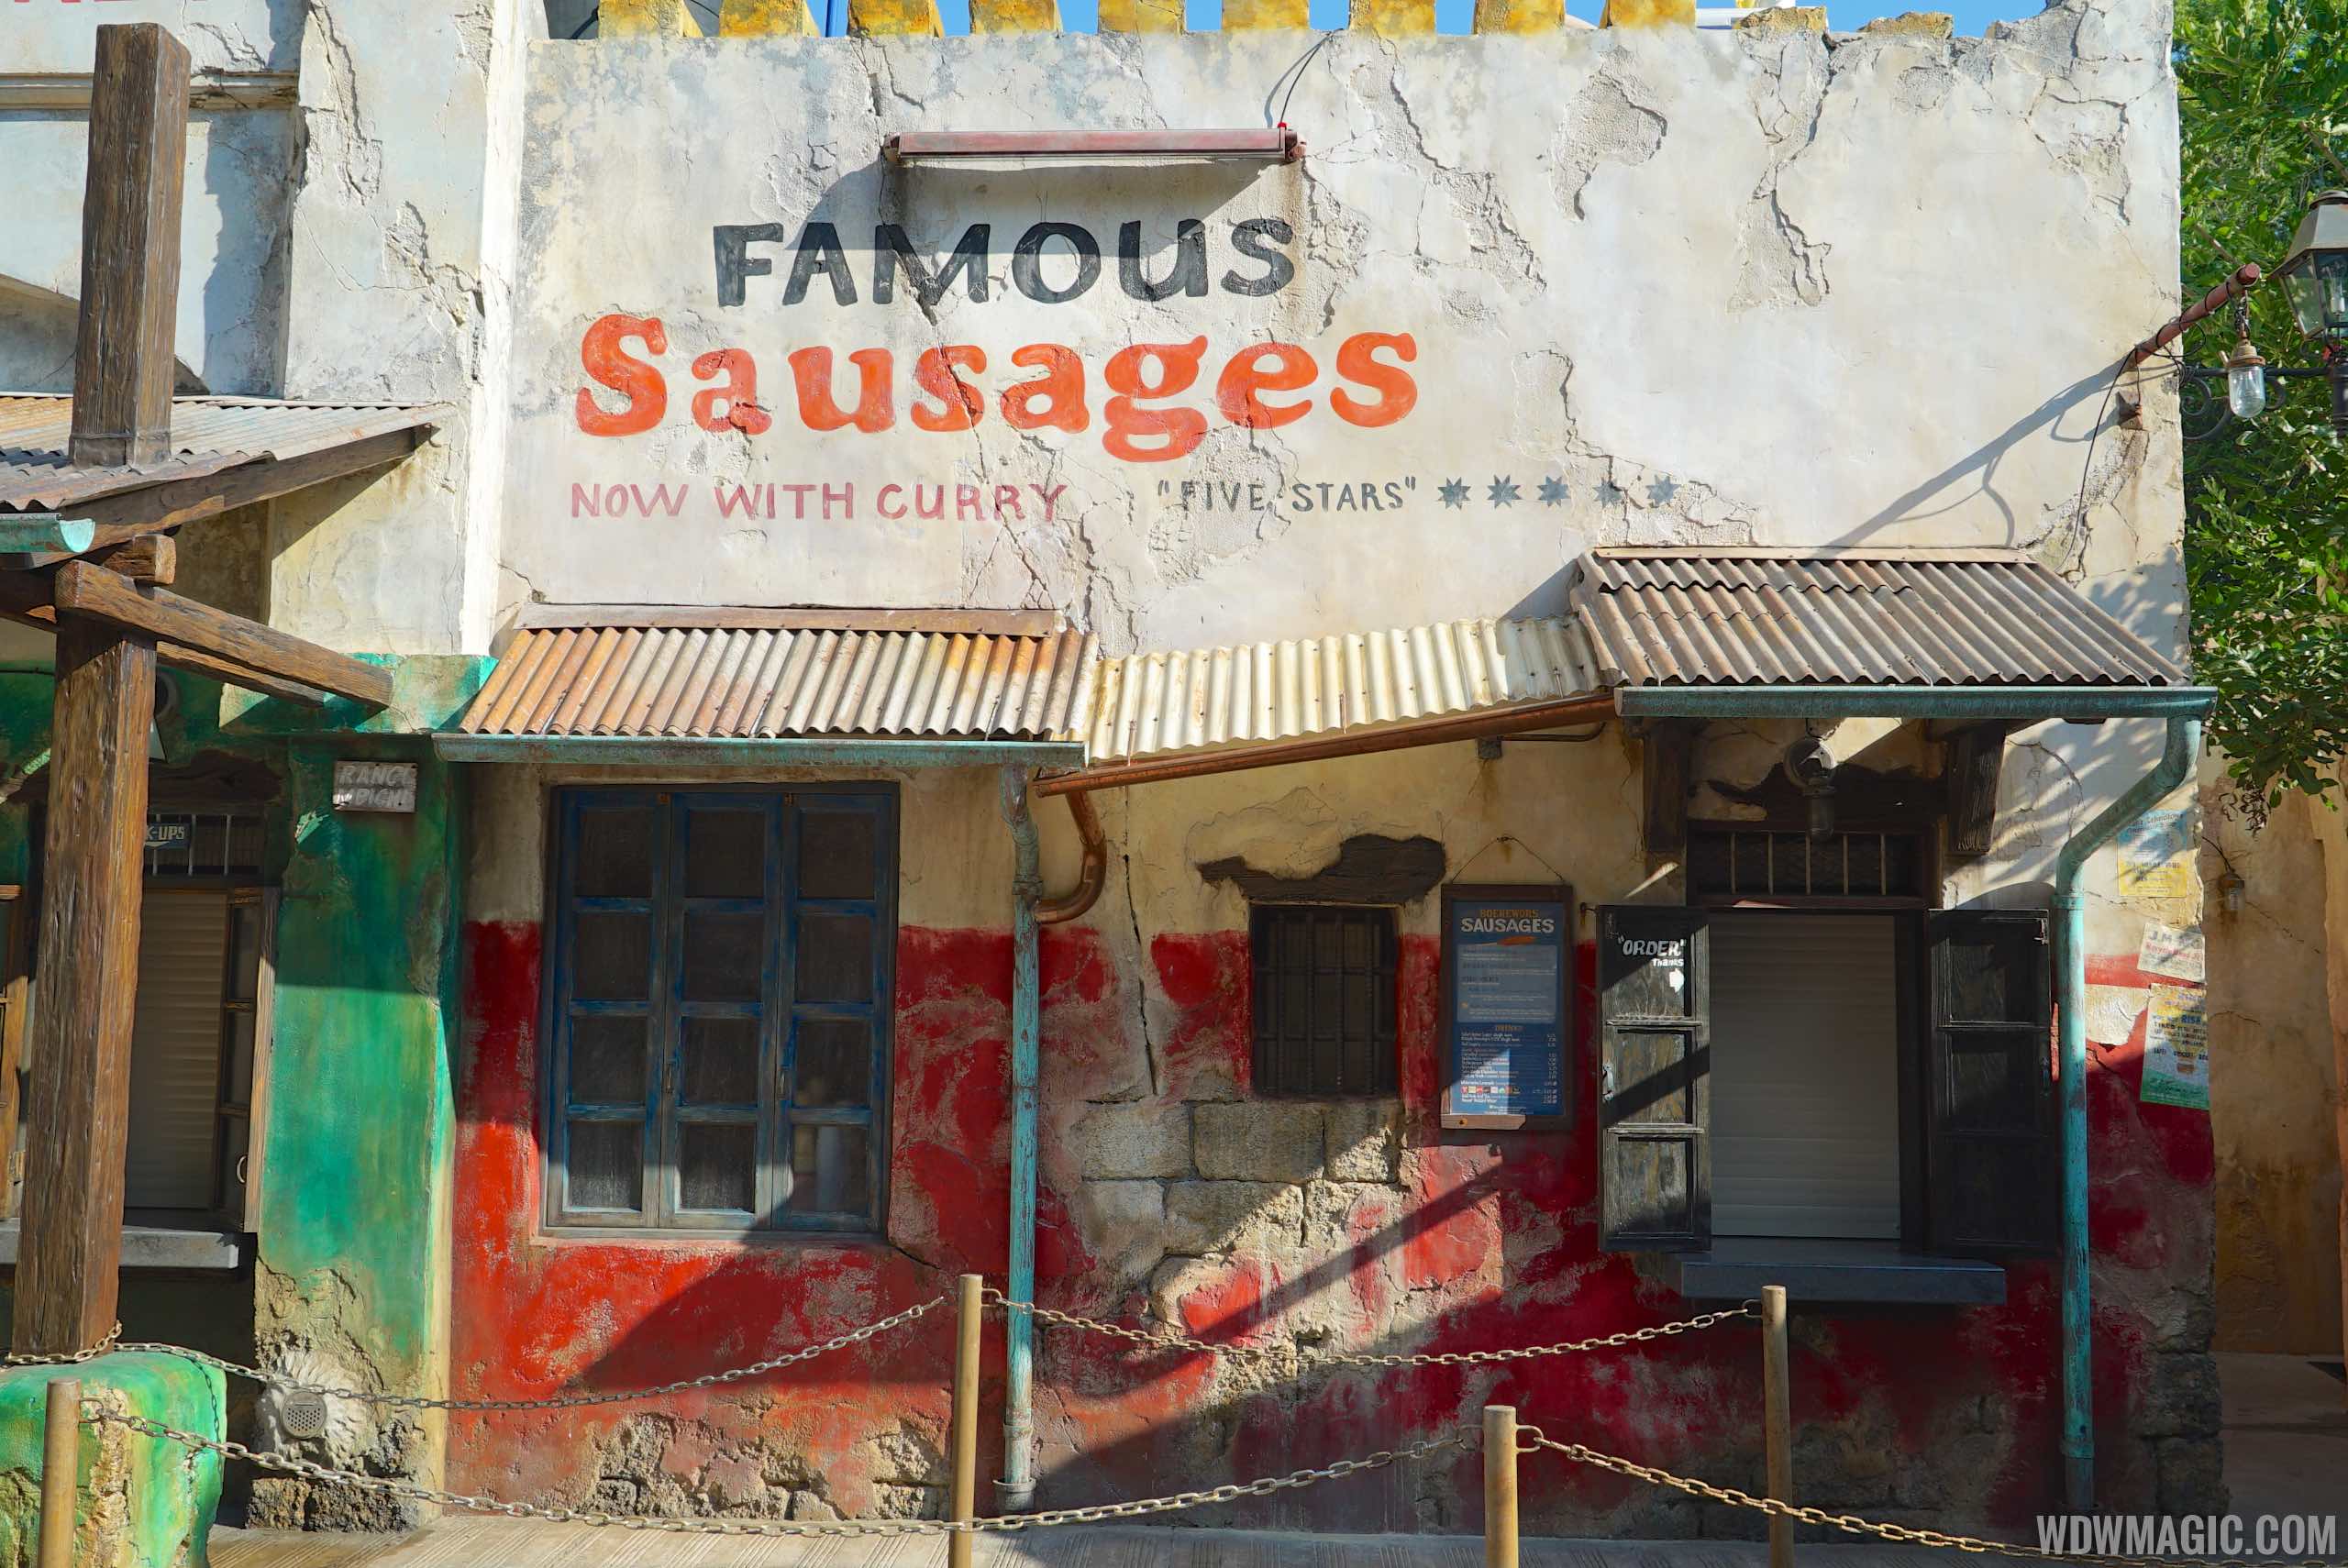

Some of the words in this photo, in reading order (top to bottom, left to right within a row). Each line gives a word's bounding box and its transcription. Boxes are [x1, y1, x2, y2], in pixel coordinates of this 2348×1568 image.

[713, 219, 1294, 307] FAMOUS
[575, 314, 1419, 464] Sausages
[570, 483, 690, 518] NOW
[714, 483, 854, 520] WITH
[876, 483, 1069, 522] CURRY
[1291, 480, 1417, 512] STARS"
[1460, 917, 1555, 933] SAUSAGES
[1652, 957, 1685, 967] Thanks
